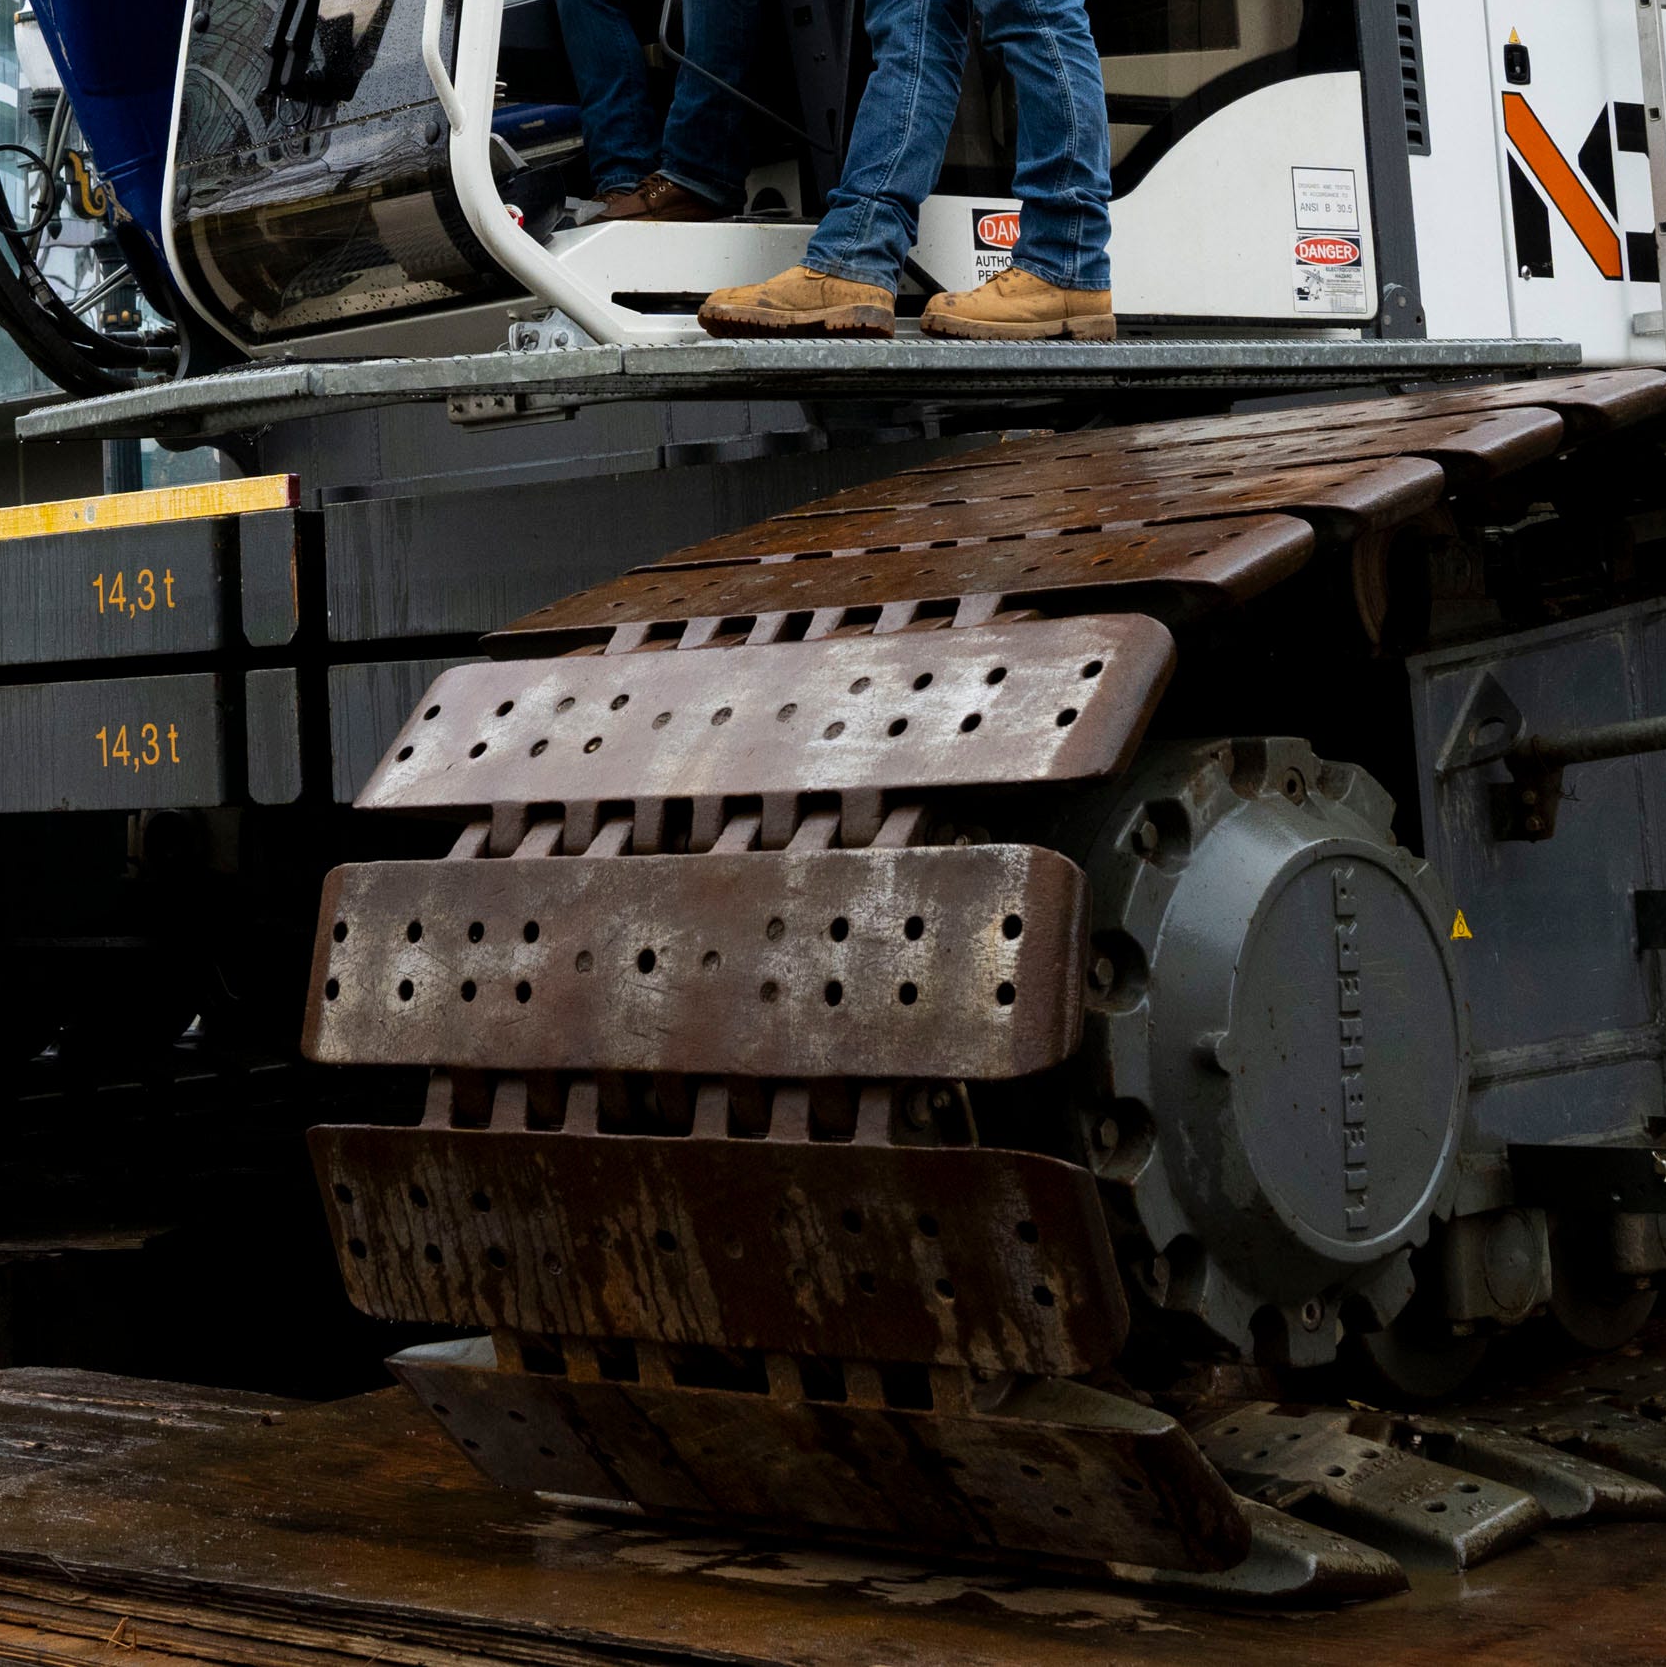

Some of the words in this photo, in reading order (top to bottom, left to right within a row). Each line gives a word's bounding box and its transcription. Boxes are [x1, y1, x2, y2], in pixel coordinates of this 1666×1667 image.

[1300, 202, 1319, 213] ANSI
[1325, 203, 1331, 213] B
[1336, 204, 1353, 214] 30.5
[984, 219, 1020, 241] DAN
[1299, 244, 1353, 260] DANGER
[92, 568, 156, 619] 14,3
[95, 723, 161, 773] 14,3
[1332, 866, 1369, 1231] LIEBHERR
